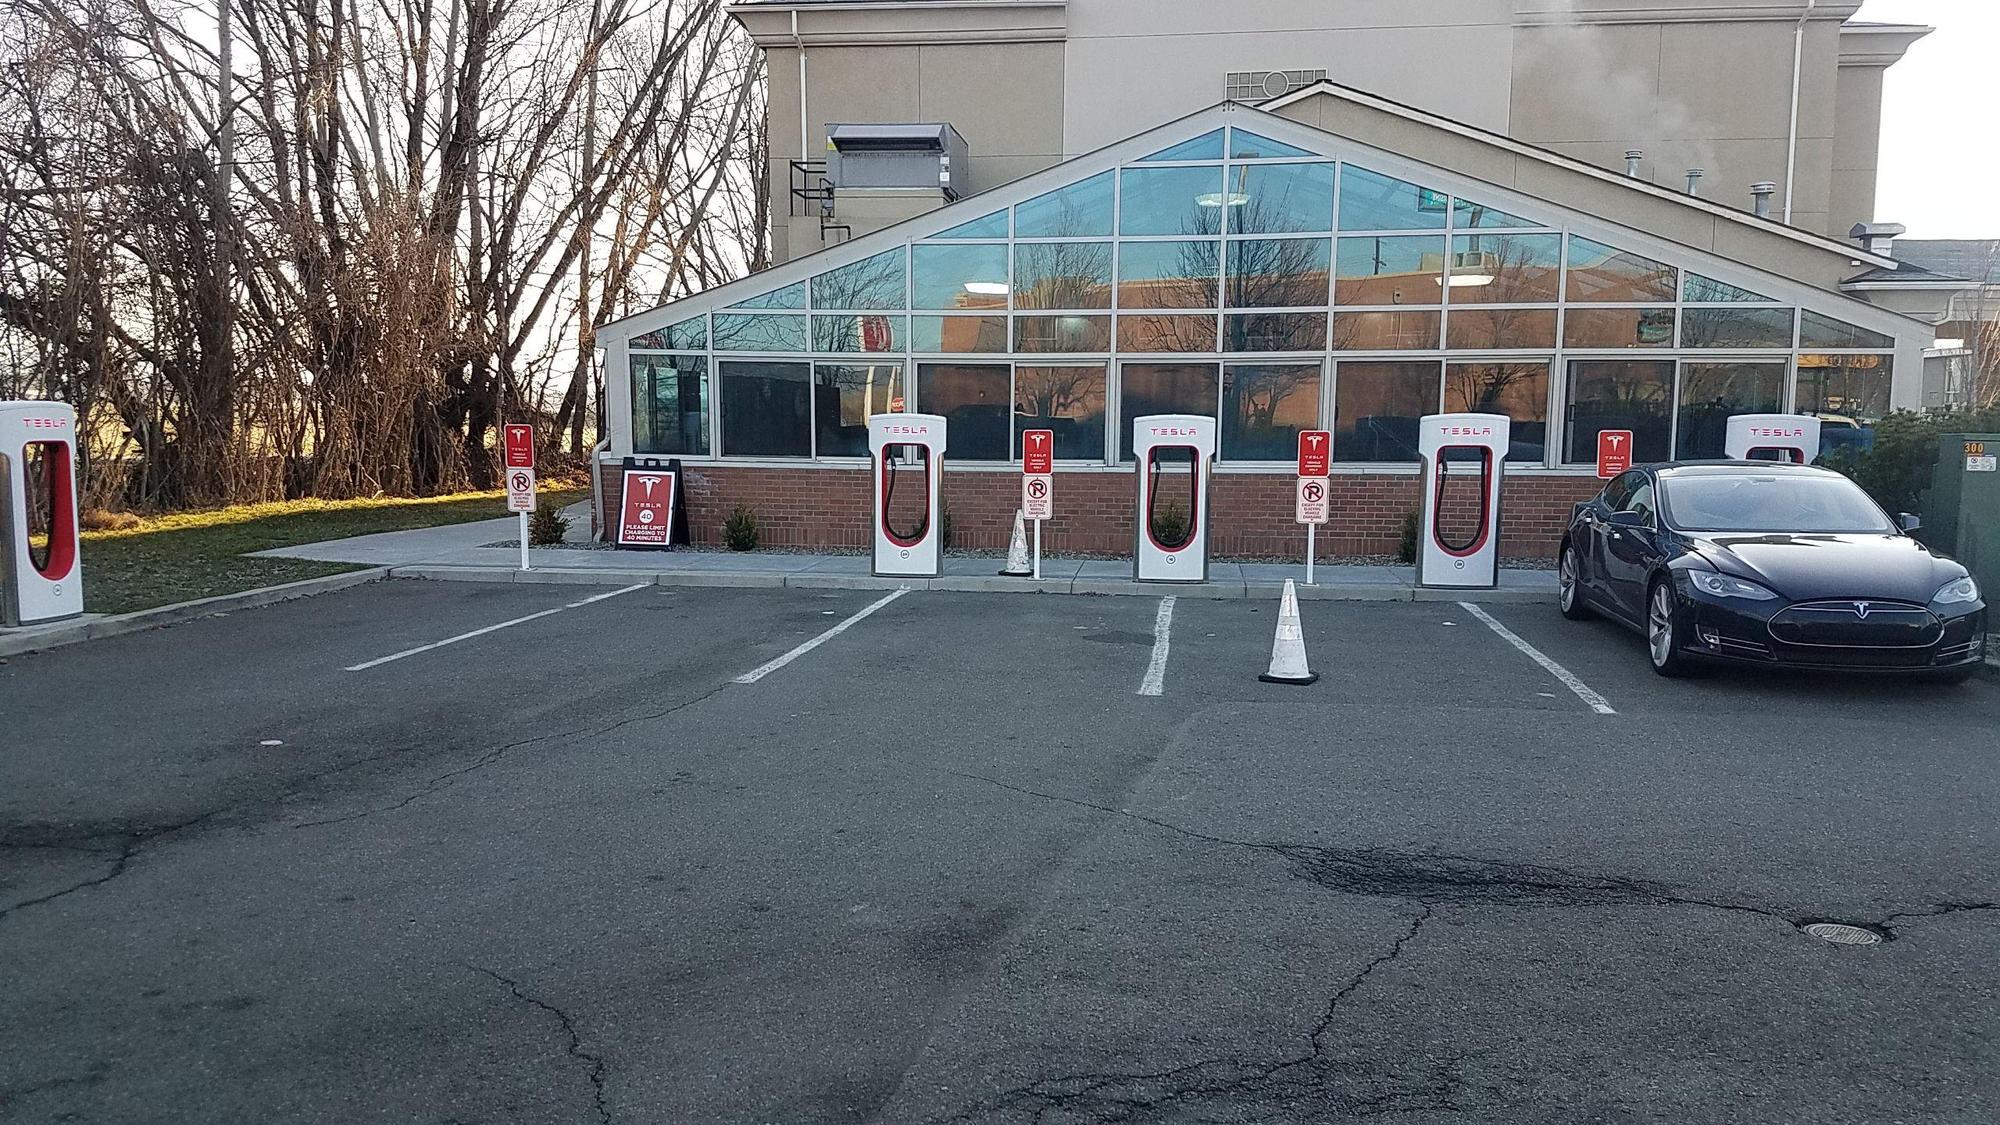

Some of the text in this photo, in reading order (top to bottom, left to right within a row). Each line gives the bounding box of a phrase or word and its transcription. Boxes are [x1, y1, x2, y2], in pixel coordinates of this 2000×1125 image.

[23, 419, 67, 428] TESLA
[883, 426, 928, 434] TESLA
[1151, 428, 1197, 436] TESLA
[1440, 427, 1491, 435] TESLA
[1750, 428, 1803, 437] TESLA
[1964, 442, 1984, 453] 300
